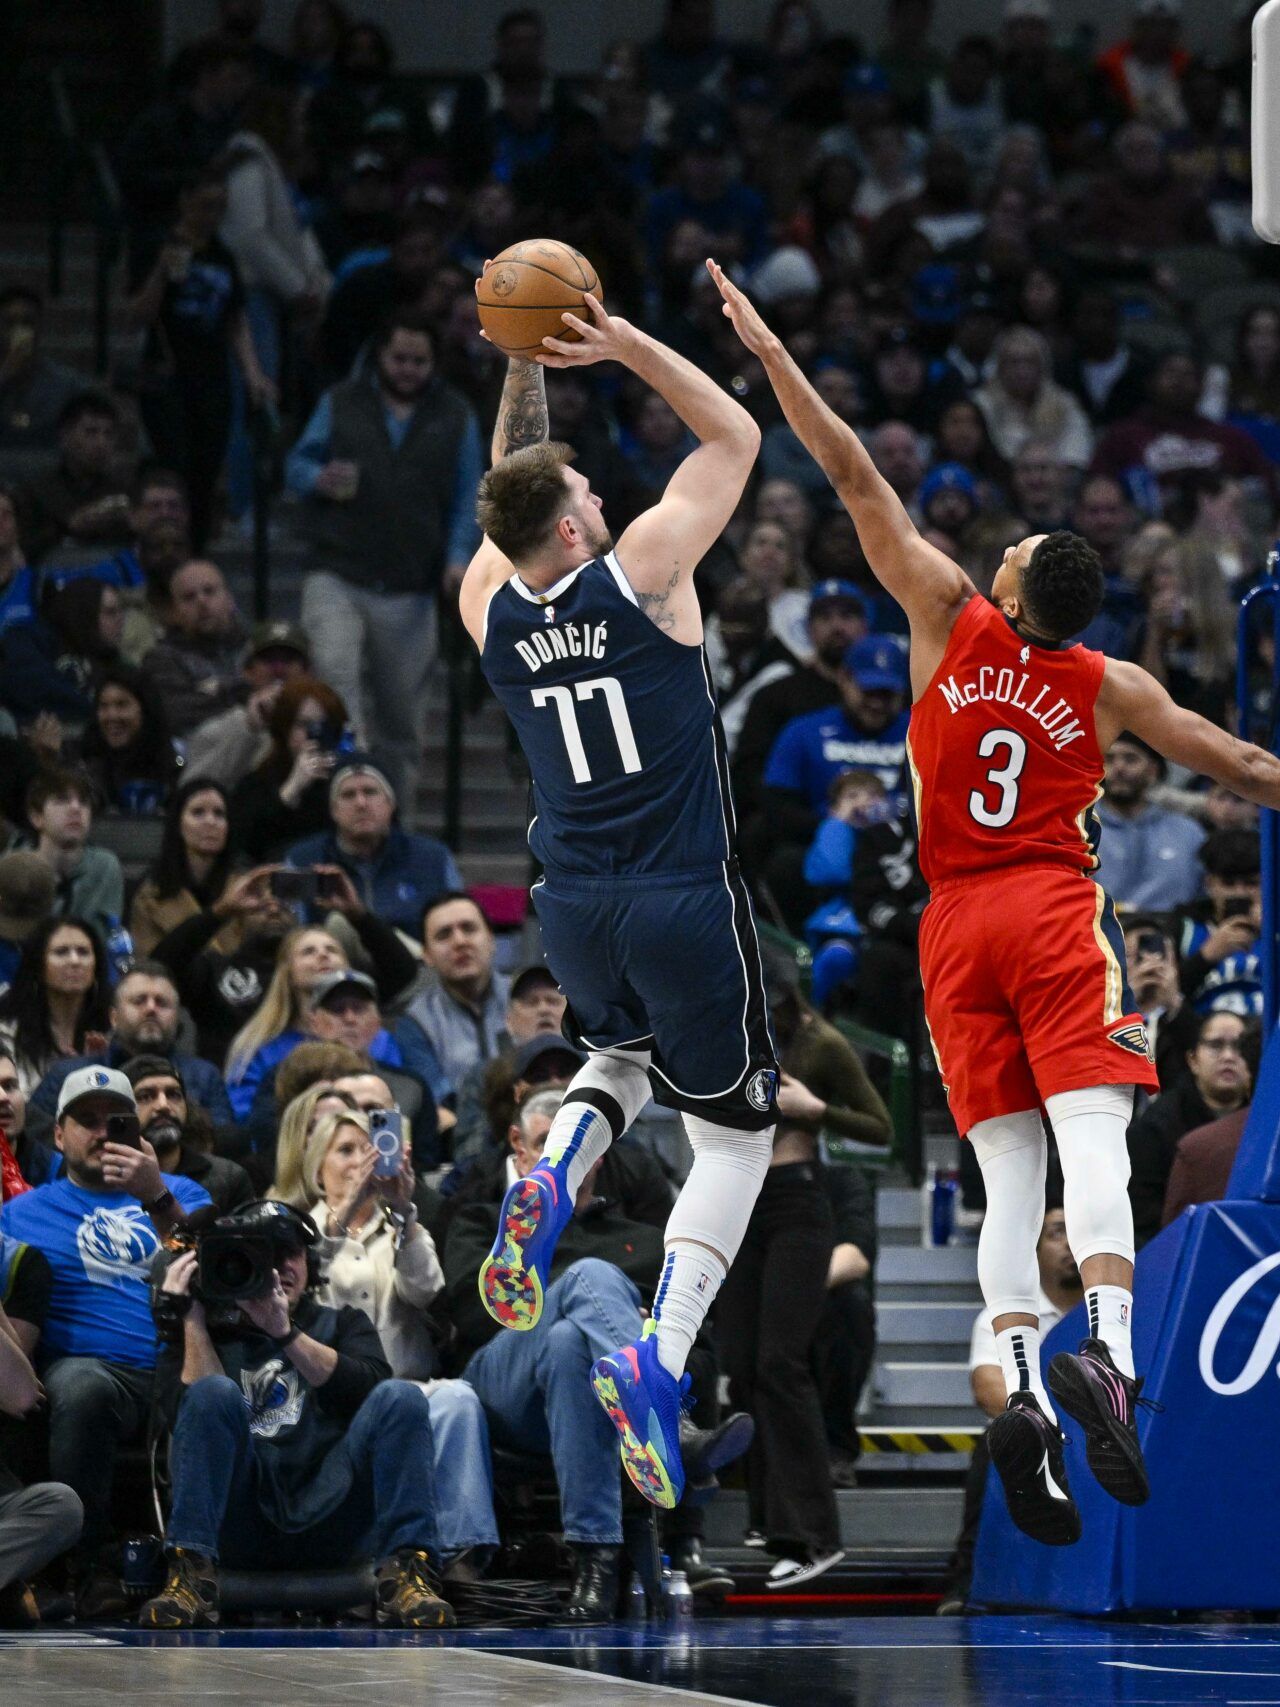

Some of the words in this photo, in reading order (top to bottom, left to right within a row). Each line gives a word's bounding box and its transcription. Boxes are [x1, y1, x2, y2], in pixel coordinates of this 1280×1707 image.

[514, 620, 608, 673] DONČIĆ
[531, 677, 643, 784] 77
[938, 666, 1085, 751] McCOLLUM
[969, 729, 1027, 828] 3
